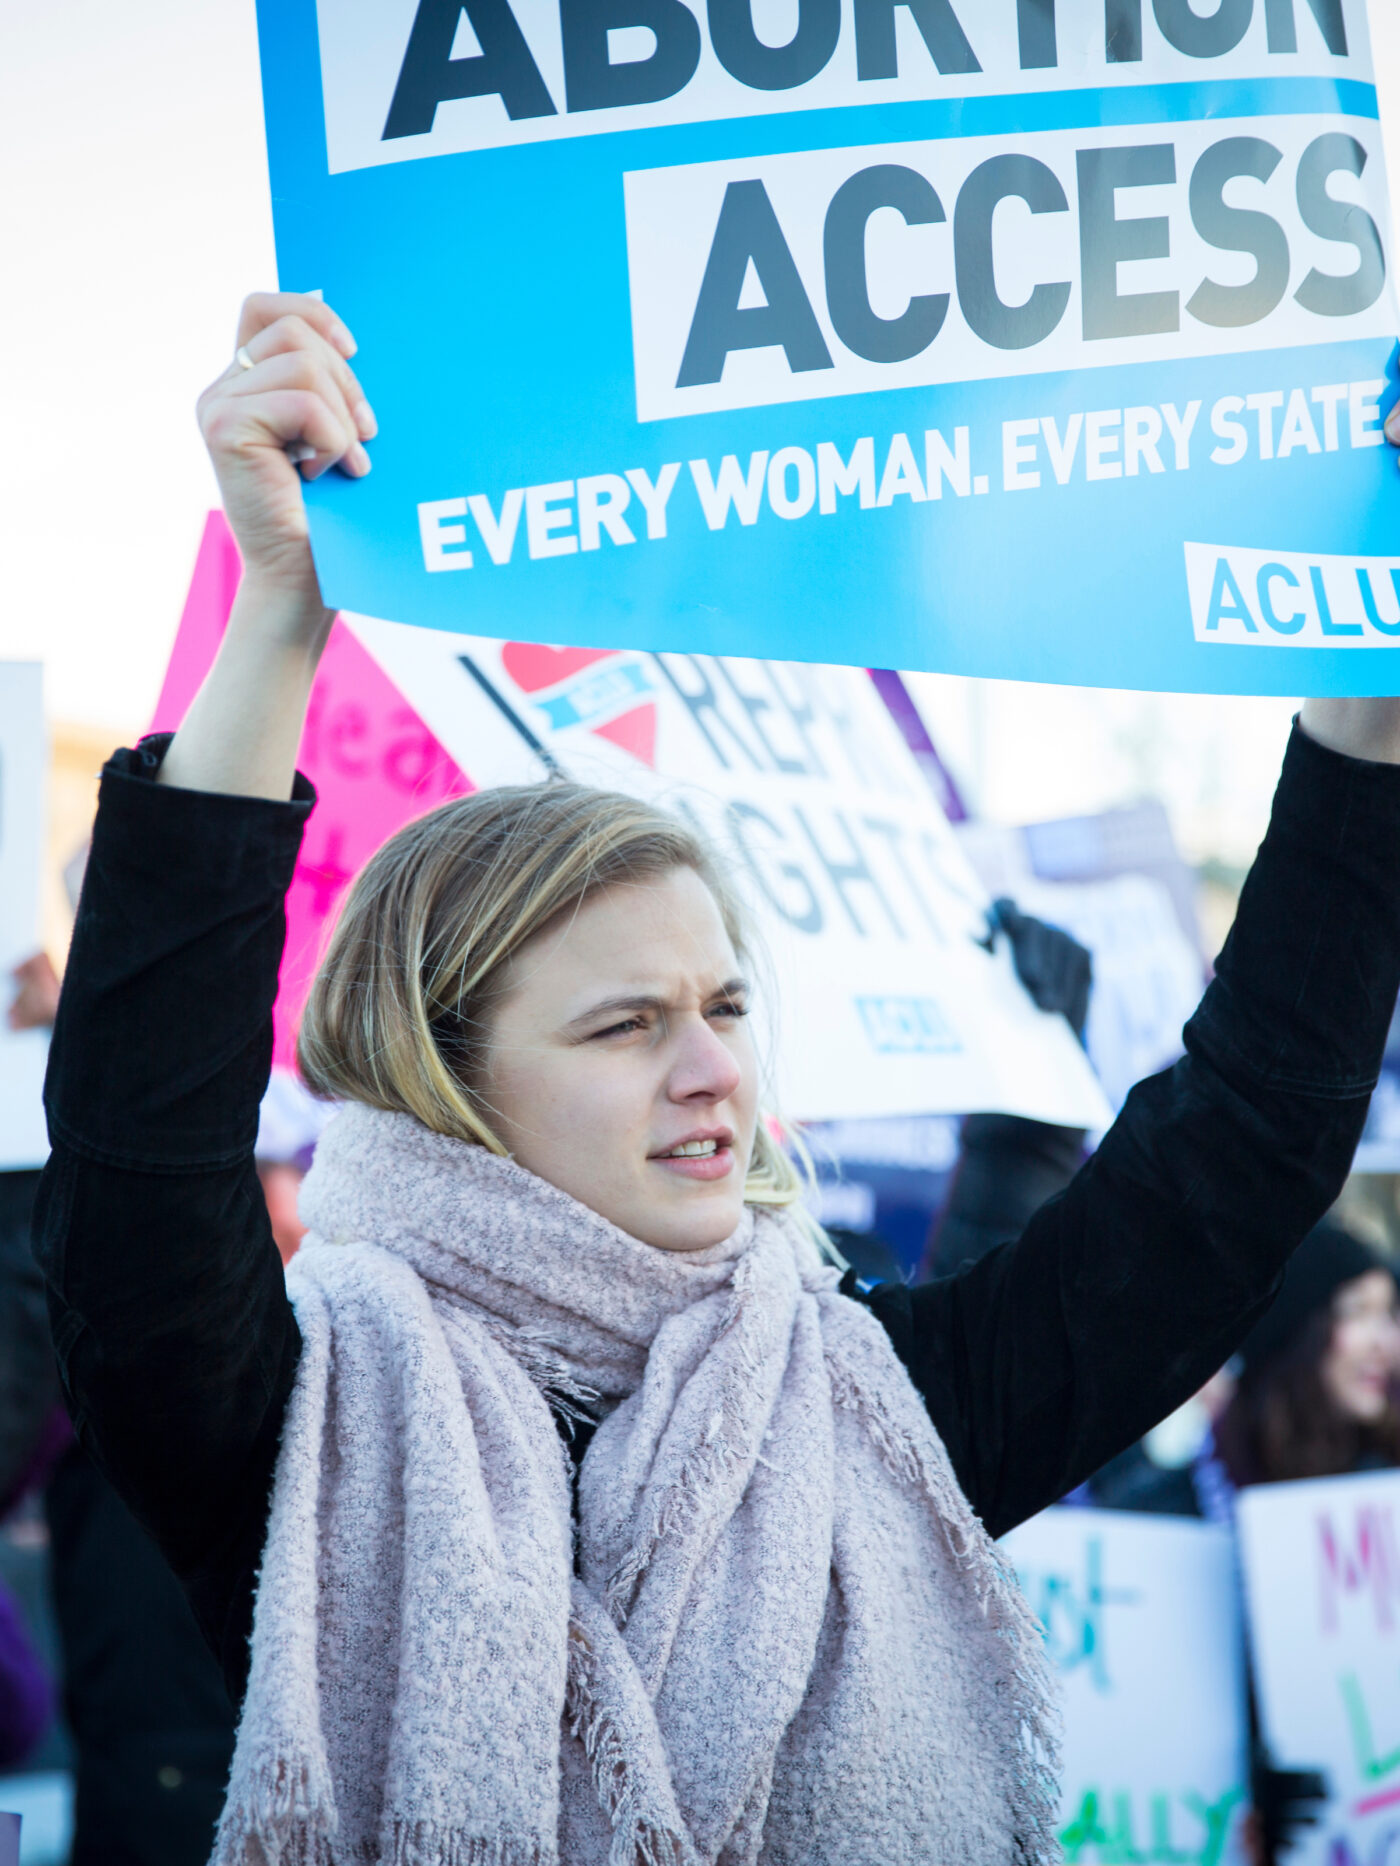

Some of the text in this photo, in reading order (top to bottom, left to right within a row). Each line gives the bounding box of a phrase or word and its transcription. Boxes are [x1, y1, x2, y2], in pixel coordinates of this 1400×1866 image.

[674, 132, 1386, 389] ACCESS
[417, 379, 1385, 572] EVERY WOMAN. EVERY STATE
[1205, 557, 1400, 636] ACLU
